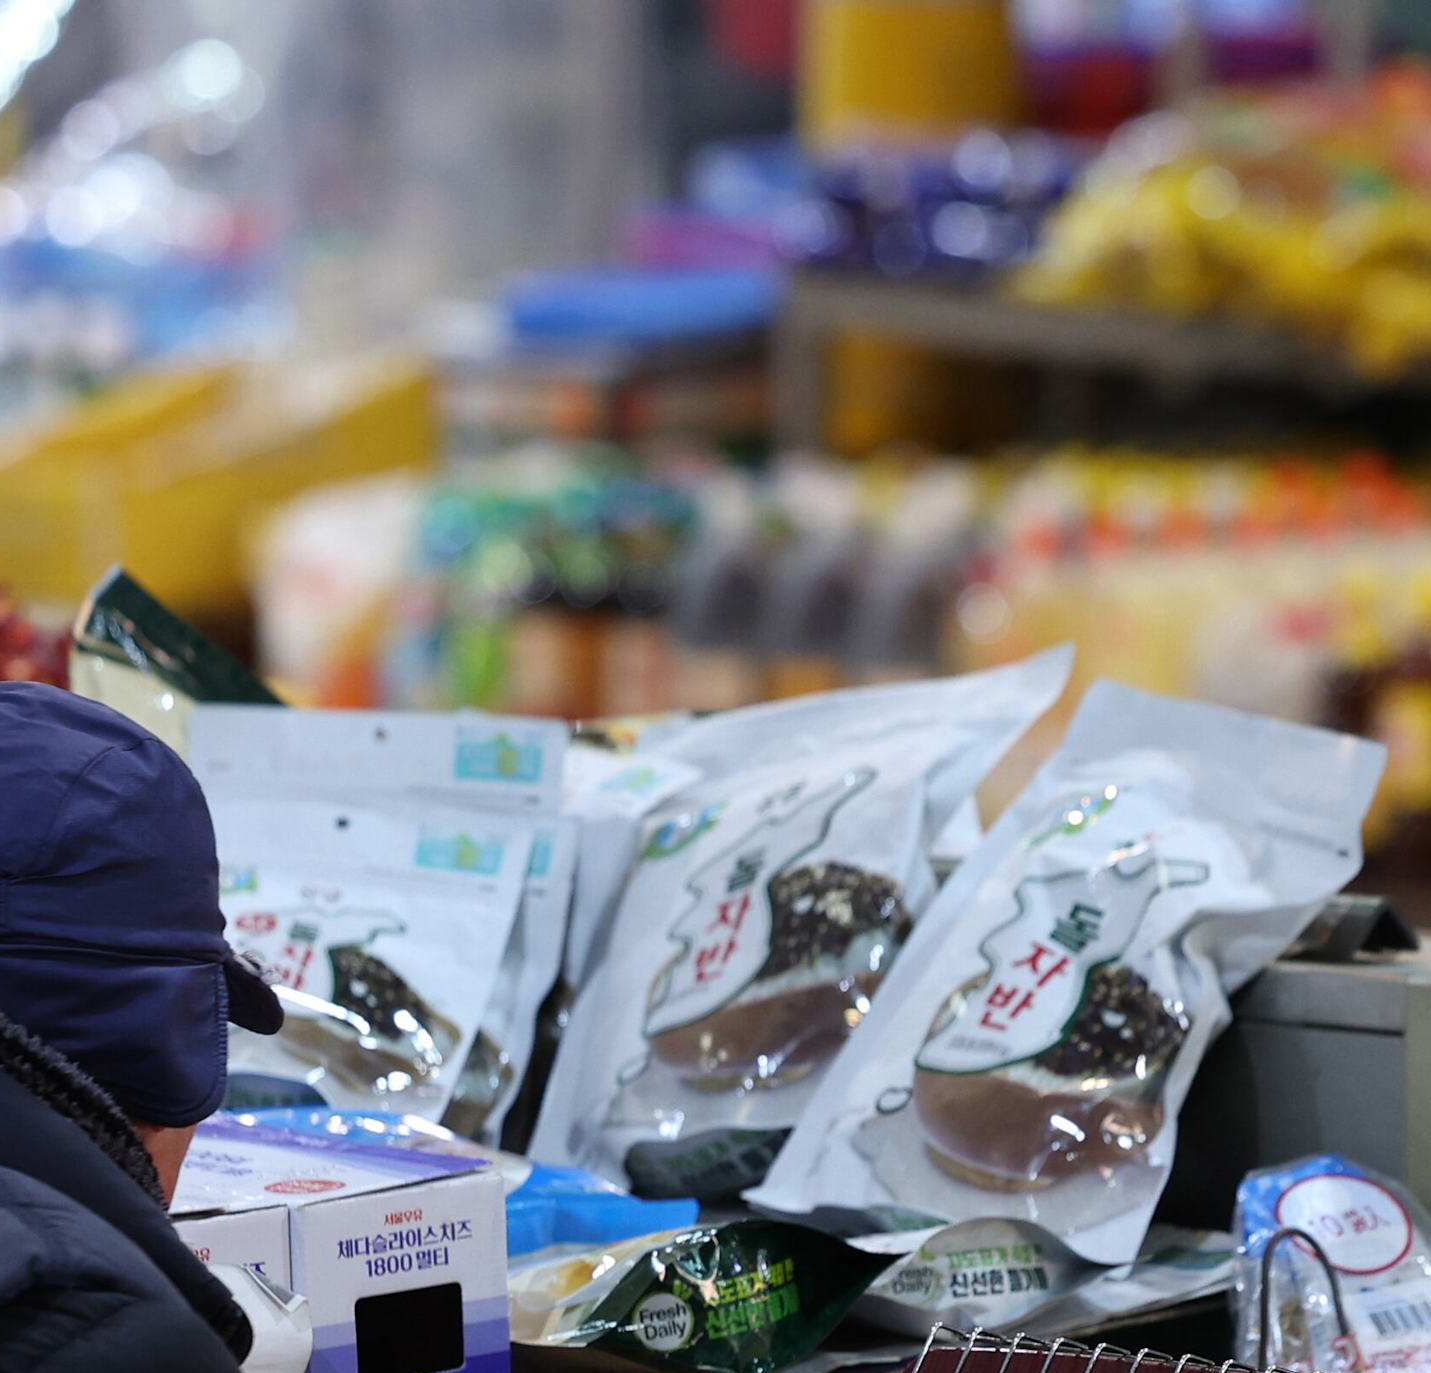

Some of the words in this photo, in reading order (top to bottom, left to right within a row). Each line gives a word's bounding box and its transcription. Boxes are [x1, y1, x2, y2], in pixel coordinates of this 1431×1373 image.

[384, 1209, 423, 1226] 서울우유
[337, 1220, 474, 1260] 체다슬라이스치즈
[365, 1252, 413, 1278] 1800
[416, 1246, 450, 1271] 멀티
[950, 1268, 1004, 1298] 신선한
[638, 1302, 687, 1325] Fresh
[643, 1319, 687, 1342] Daily
